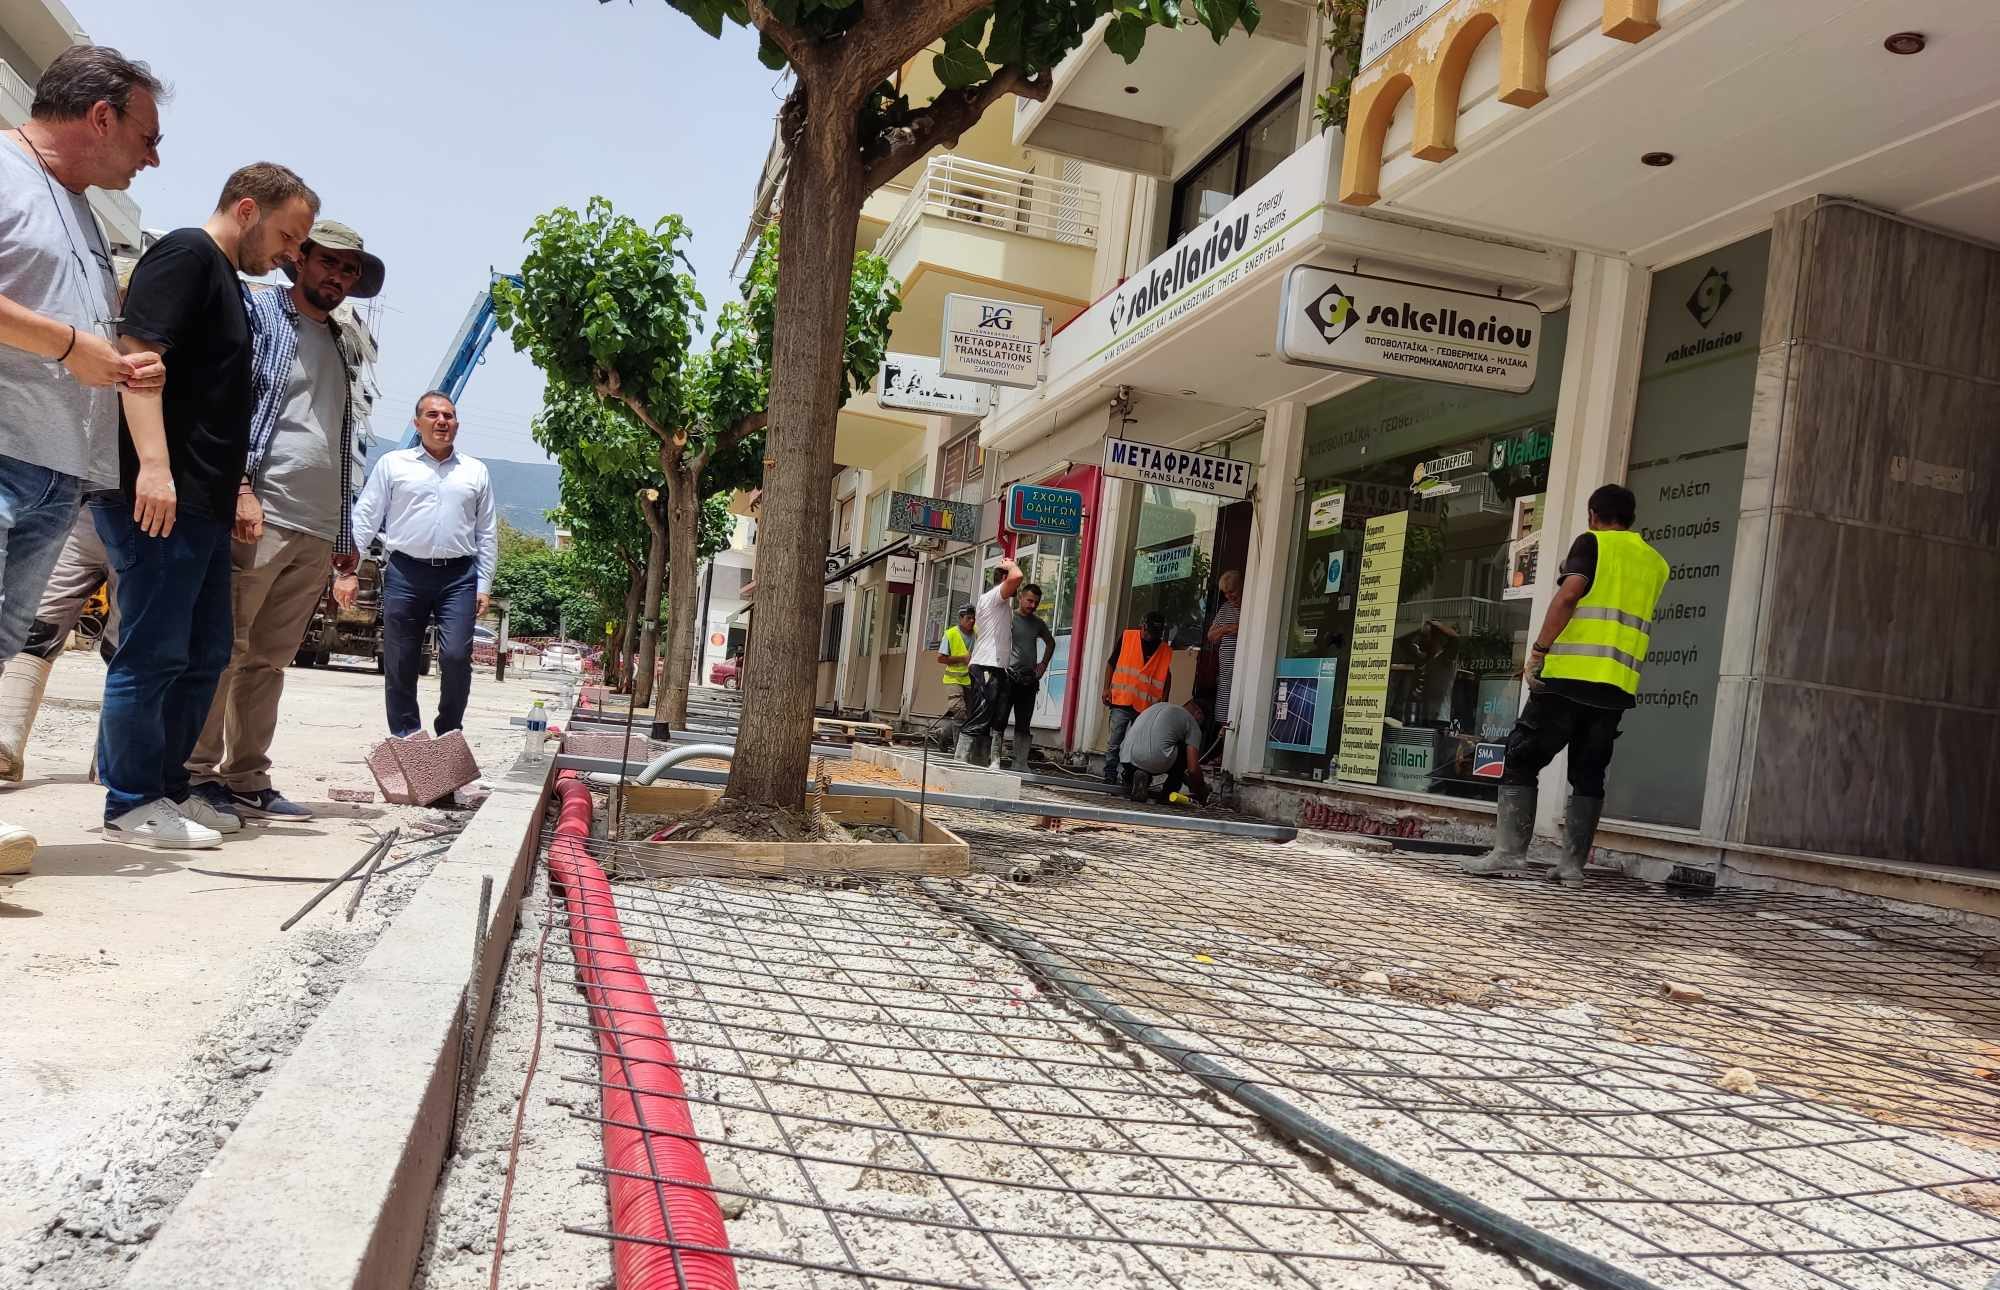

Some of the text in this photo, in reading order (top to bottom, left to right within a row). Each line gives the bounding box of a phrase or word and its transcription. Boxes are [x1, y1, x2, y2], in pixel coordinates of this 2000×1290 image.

[1256, 191, 1284, 218] Energy
[1253, 209, 1286, 241] Systems
[1127, 213, 1249, 326] sakellariou
[1156, 314, 1167, 328] ΚΑΙ
[1169, 284, 1215, 321] ΑΝΑΝΕΩΣΙΜΕΣ
[1217, 269, 1239, 292] ΠΗΓΕΣ
[1244, 238, 1286, 274] ΕΝΕΡΓΕΙΑΣ
[1366, 303, 1532, 348] sakellariou
[954, 335, 1033, 354] ΜΕΤΑΦΡΑΣΕΙΣ
[954, 345, 1032, 364] TRANSLATIONS
[1364, 336, 1428, 353] ΦΩΤΟΒΟΛΤΑΪΚΑ
[1436, 348, 1489, 362] ΓΕΩΘΕΡΜΙΚΑ
[1497, 357, 1528, 368] ΗΛΙΑΚΑ
[1665, 330, 1742, 363] sakellariou
[959, 357, 1024, 371] ΓΙΑΝΝΑΚΟΠΟΥΛΟΥ
[1382, 353, 1507, 377] ΗΛΕΚΤΡΟΜΗΧΑΝΟΛΟΓΙΚΑ ΕΡΓΑ
[1112, 442, 1244, 485] ΜΕΤΑΦΡΑΣΕΙΣ
[1138, 469, 1215, 490] TRANSLATIONS
[1032, 491, 1073, 505] ΣΧΟΛΗ
[1659, 481, 1711, 501] Μελέτη
[1026, 502, 1077, 517] ΟΔΗΓΩΝ
[1039, 516, 1066, 526] ΝΙΚΑ
[1641, 517, 1721, 542] Σχεδιασμός
[1156, 561, 1179, 574] ΚΕΝΤΡΟ
[1652, 603, 1707, 624] ομήθεια
[1647, 643, 1698, 665] αρμογή
[1636, 688, 1699, 708] οστήριξη
[1384, 748, 1428, 768] Vaillant
[1477, 748, 1494, 759] SMA
